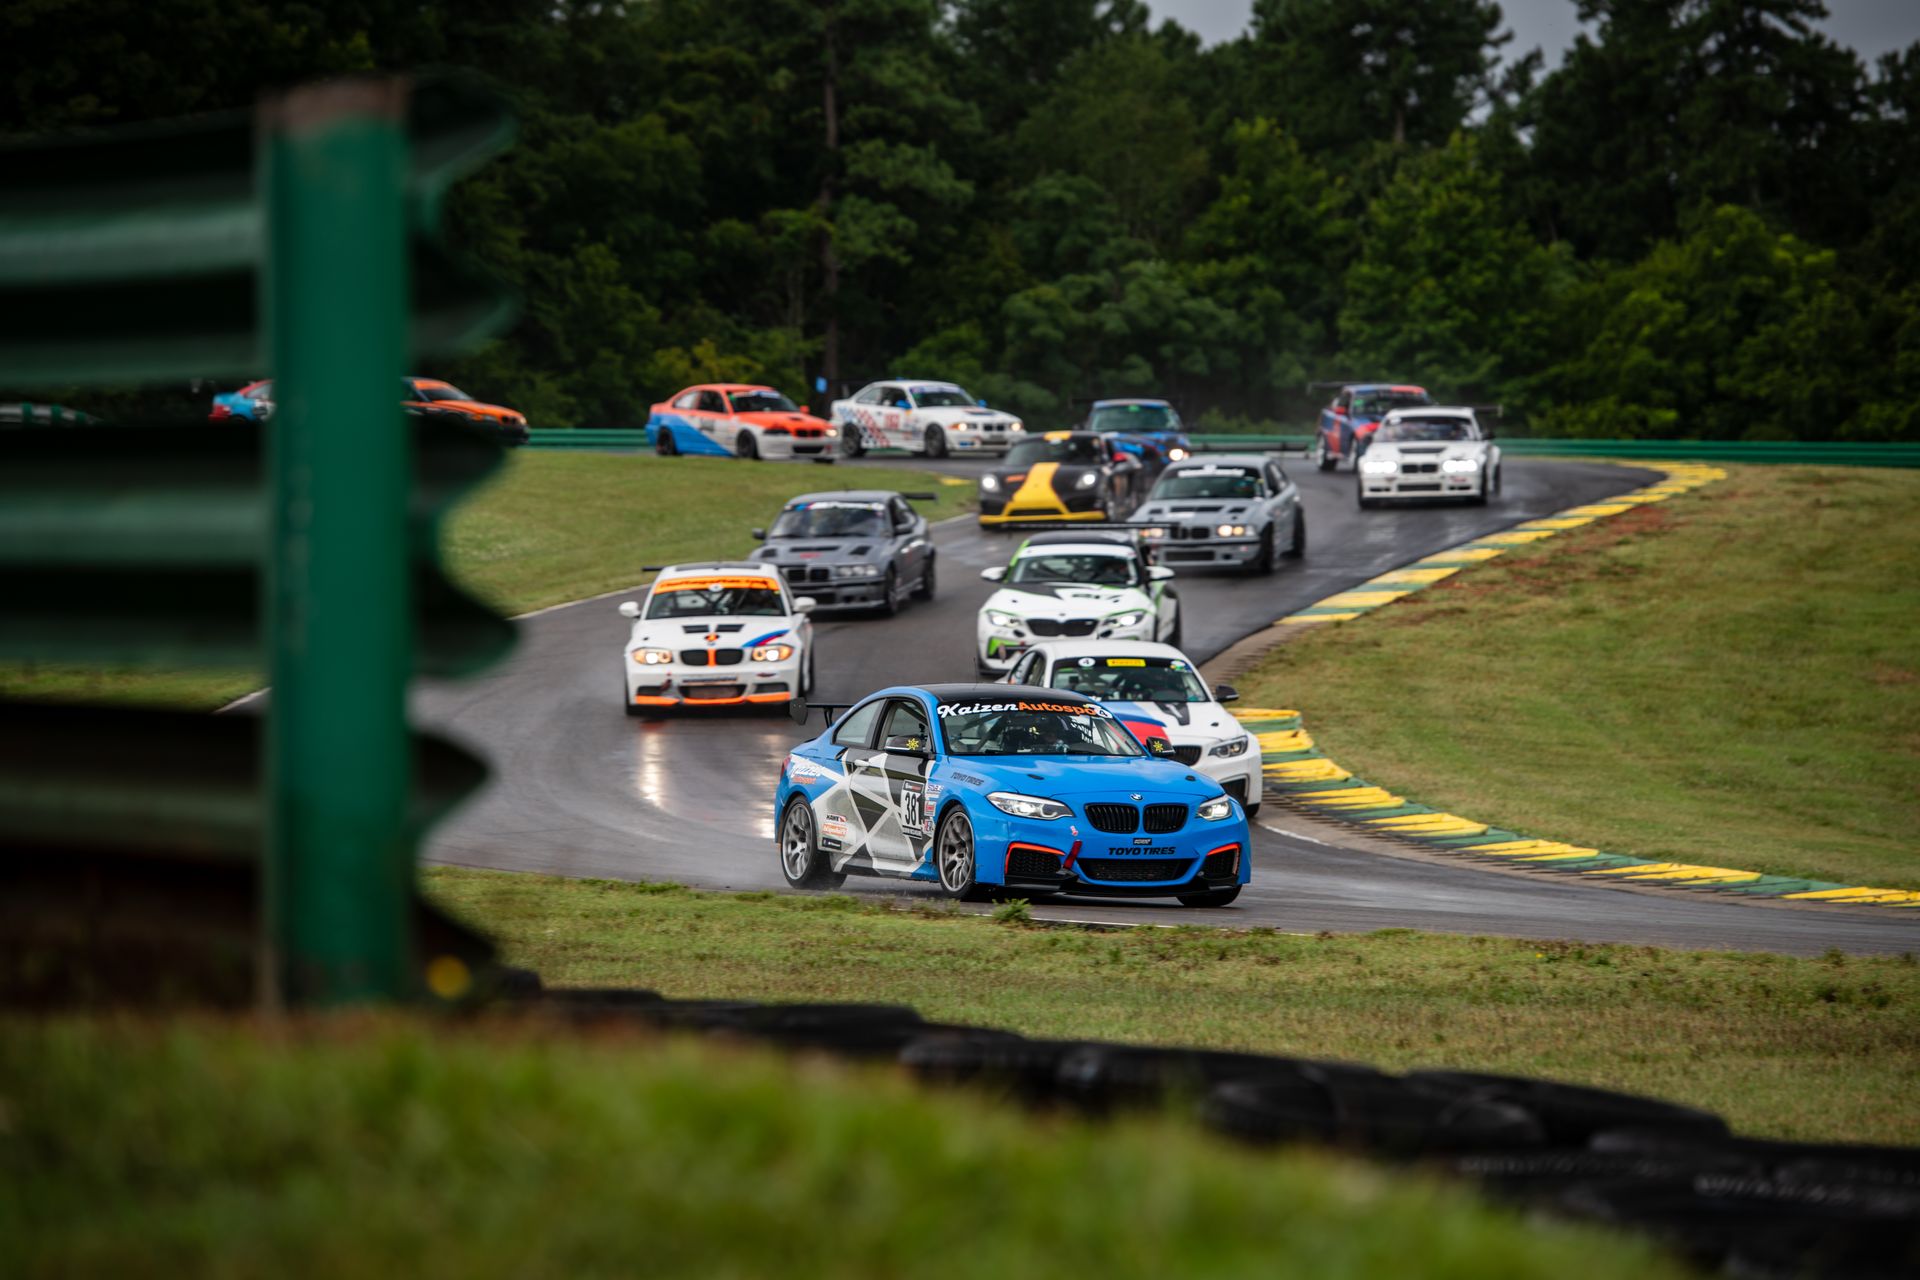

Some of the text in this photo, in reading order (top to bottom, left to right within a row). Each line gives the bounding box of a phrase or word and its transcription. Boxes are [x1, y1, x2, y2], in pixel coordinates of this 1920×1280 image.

[937, 703, 1018, 718] Kaizen
[1108, 846, 1176, 856] TOYO TIRES
